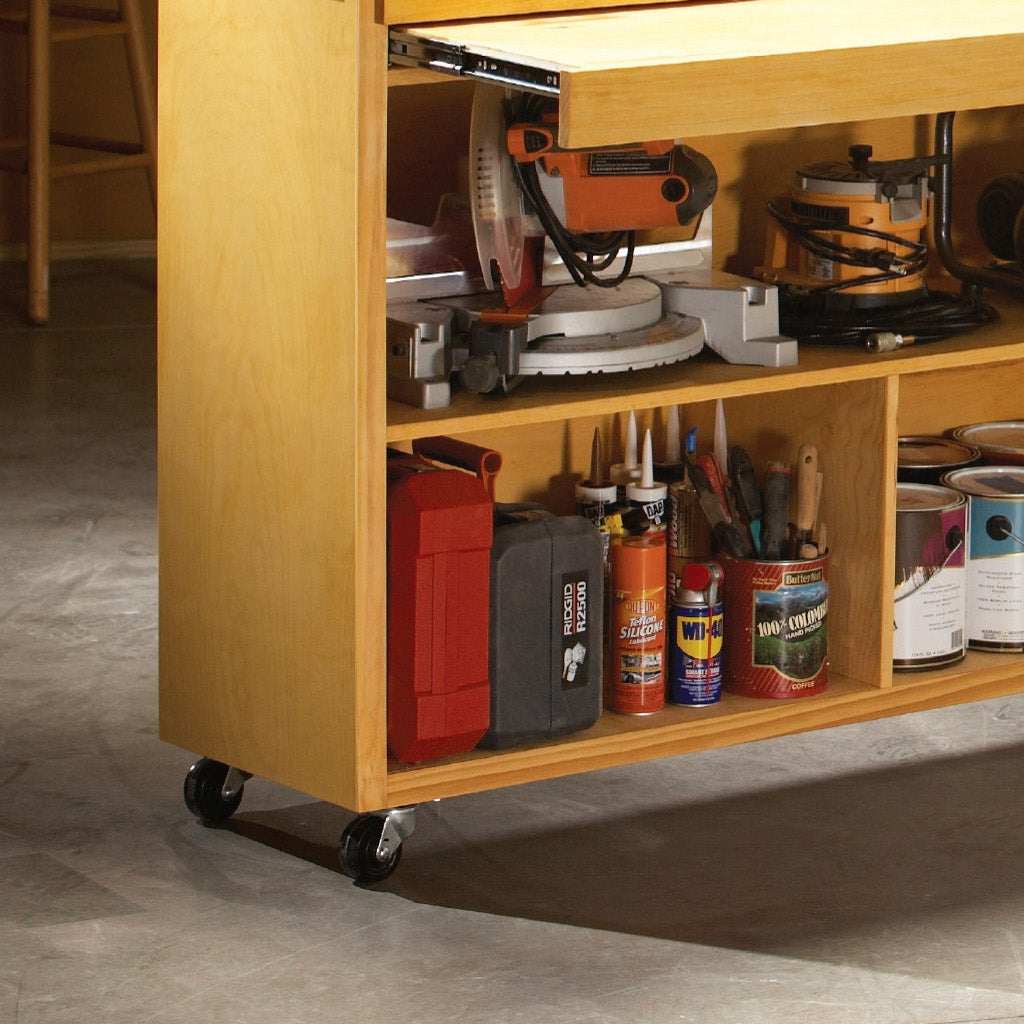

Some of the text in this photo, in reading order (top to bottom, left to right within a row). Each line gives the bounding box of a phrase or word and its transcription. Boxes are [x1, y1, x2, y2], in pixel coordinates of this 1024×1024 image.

[646, 501, 664, 517] DAP
[563, 583, 573, 636] RIDGID
[576, 580, 587, 633] R2500
[619, 619, 664, 639] SILICONE
[630, 615, 657, 627] Teflon
[681, 618, 723, 640] WD-40
[757, 617, 787, 637] 100%
[785, 629, 804, 639] HAND
[791, 680, 815, 690] COFFEE
